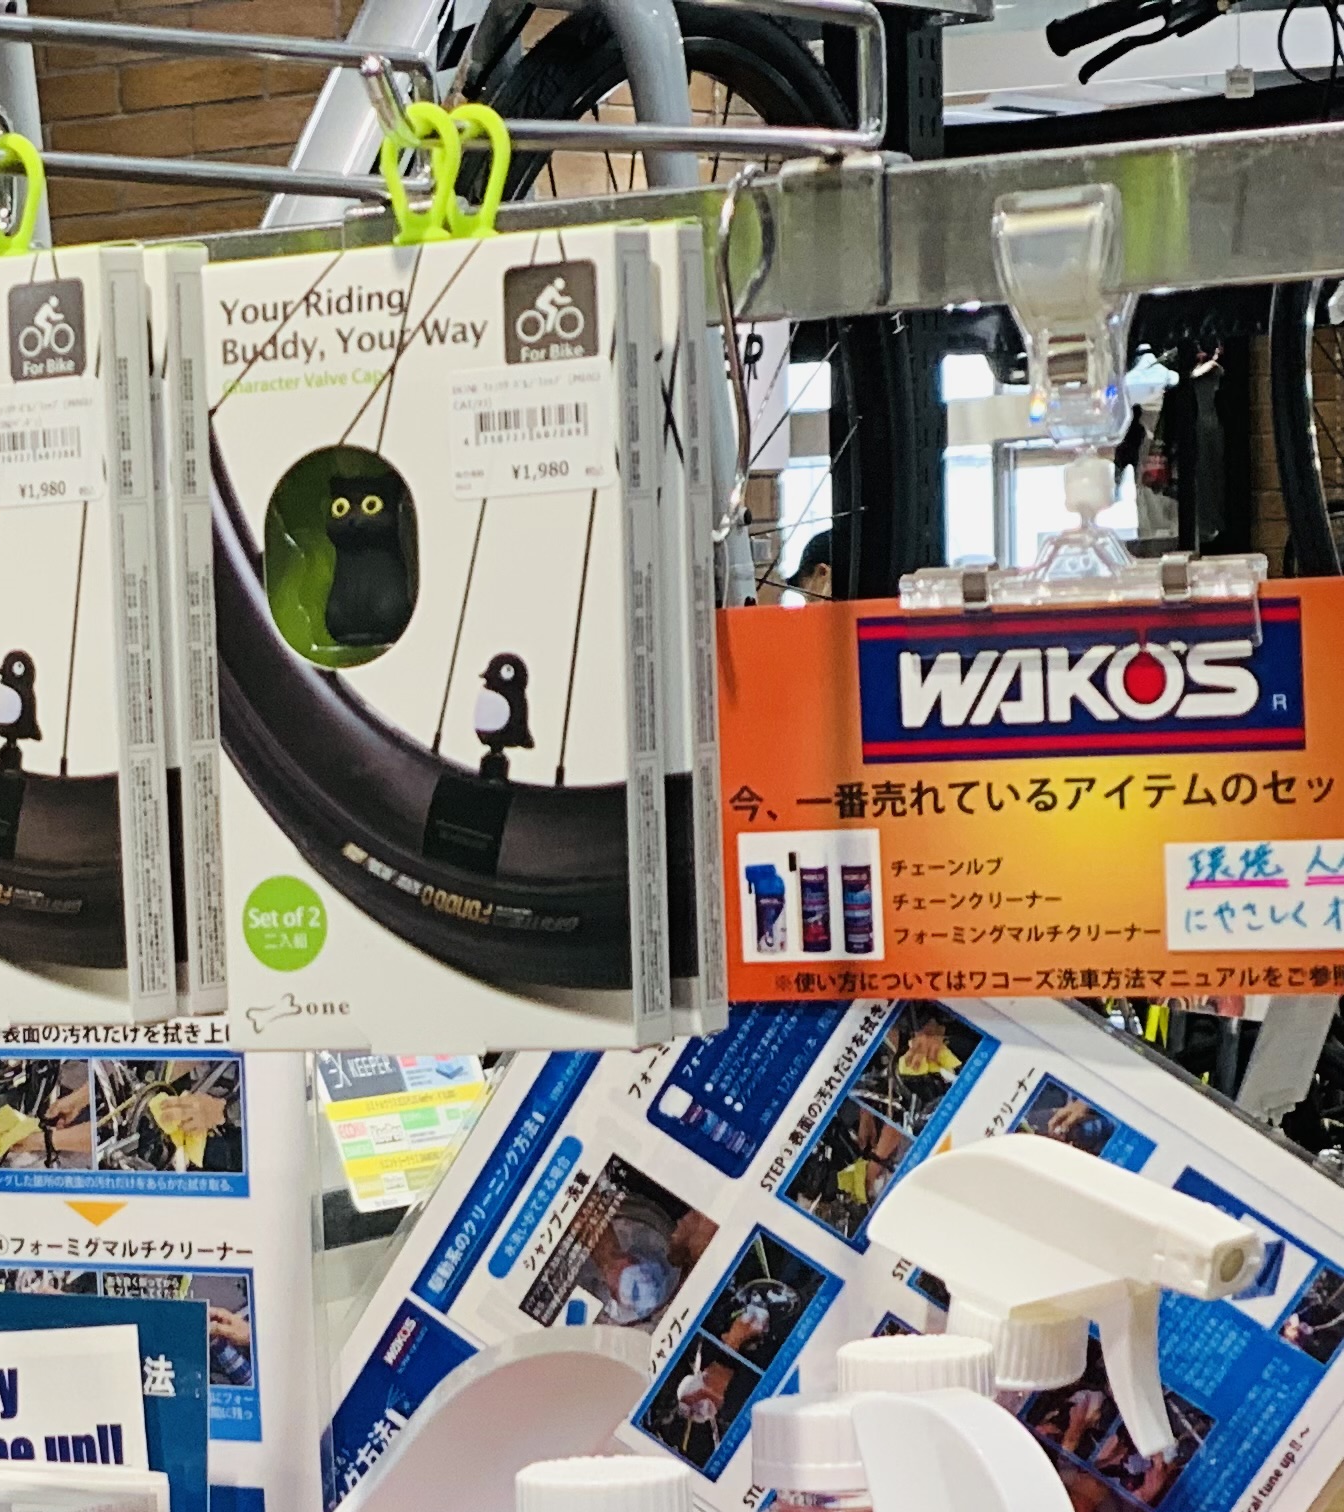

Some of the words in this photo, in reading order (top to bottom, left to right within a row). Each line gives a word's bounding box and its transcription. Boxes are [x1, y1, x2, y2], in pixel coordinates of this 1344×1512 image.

[220, 299, 294, 325] Your
[304, 287, 407, 318] Riding
[222, 336, 326, 366] Buddy,
[335, 327, 412, 355] Your
[421, 317, 489, 348] Way
[520, 345, 544, 361] For
[548, 342, 585, 358] Bike
[22, 361, 43, 377] For
[45, 359, 76, 374] Bike
[304, 371, 348, 389] Valve
[512, 461, 570, 480] ¥1,980
[19, 480, 66, 499] ¥1,980
[891, 856, 1004, 877] チェーンルブ
[892, 891, 1063, 912] チェーンクリーナー
[248, 907, 279, 927] Set
[282, 905, 301, 926] of
[308, 905, 321, 924] 2
[1184, 900, 1308, 933] にやさしく
[894, 922, 1162, 945] フォーミングマルチクリーナー
